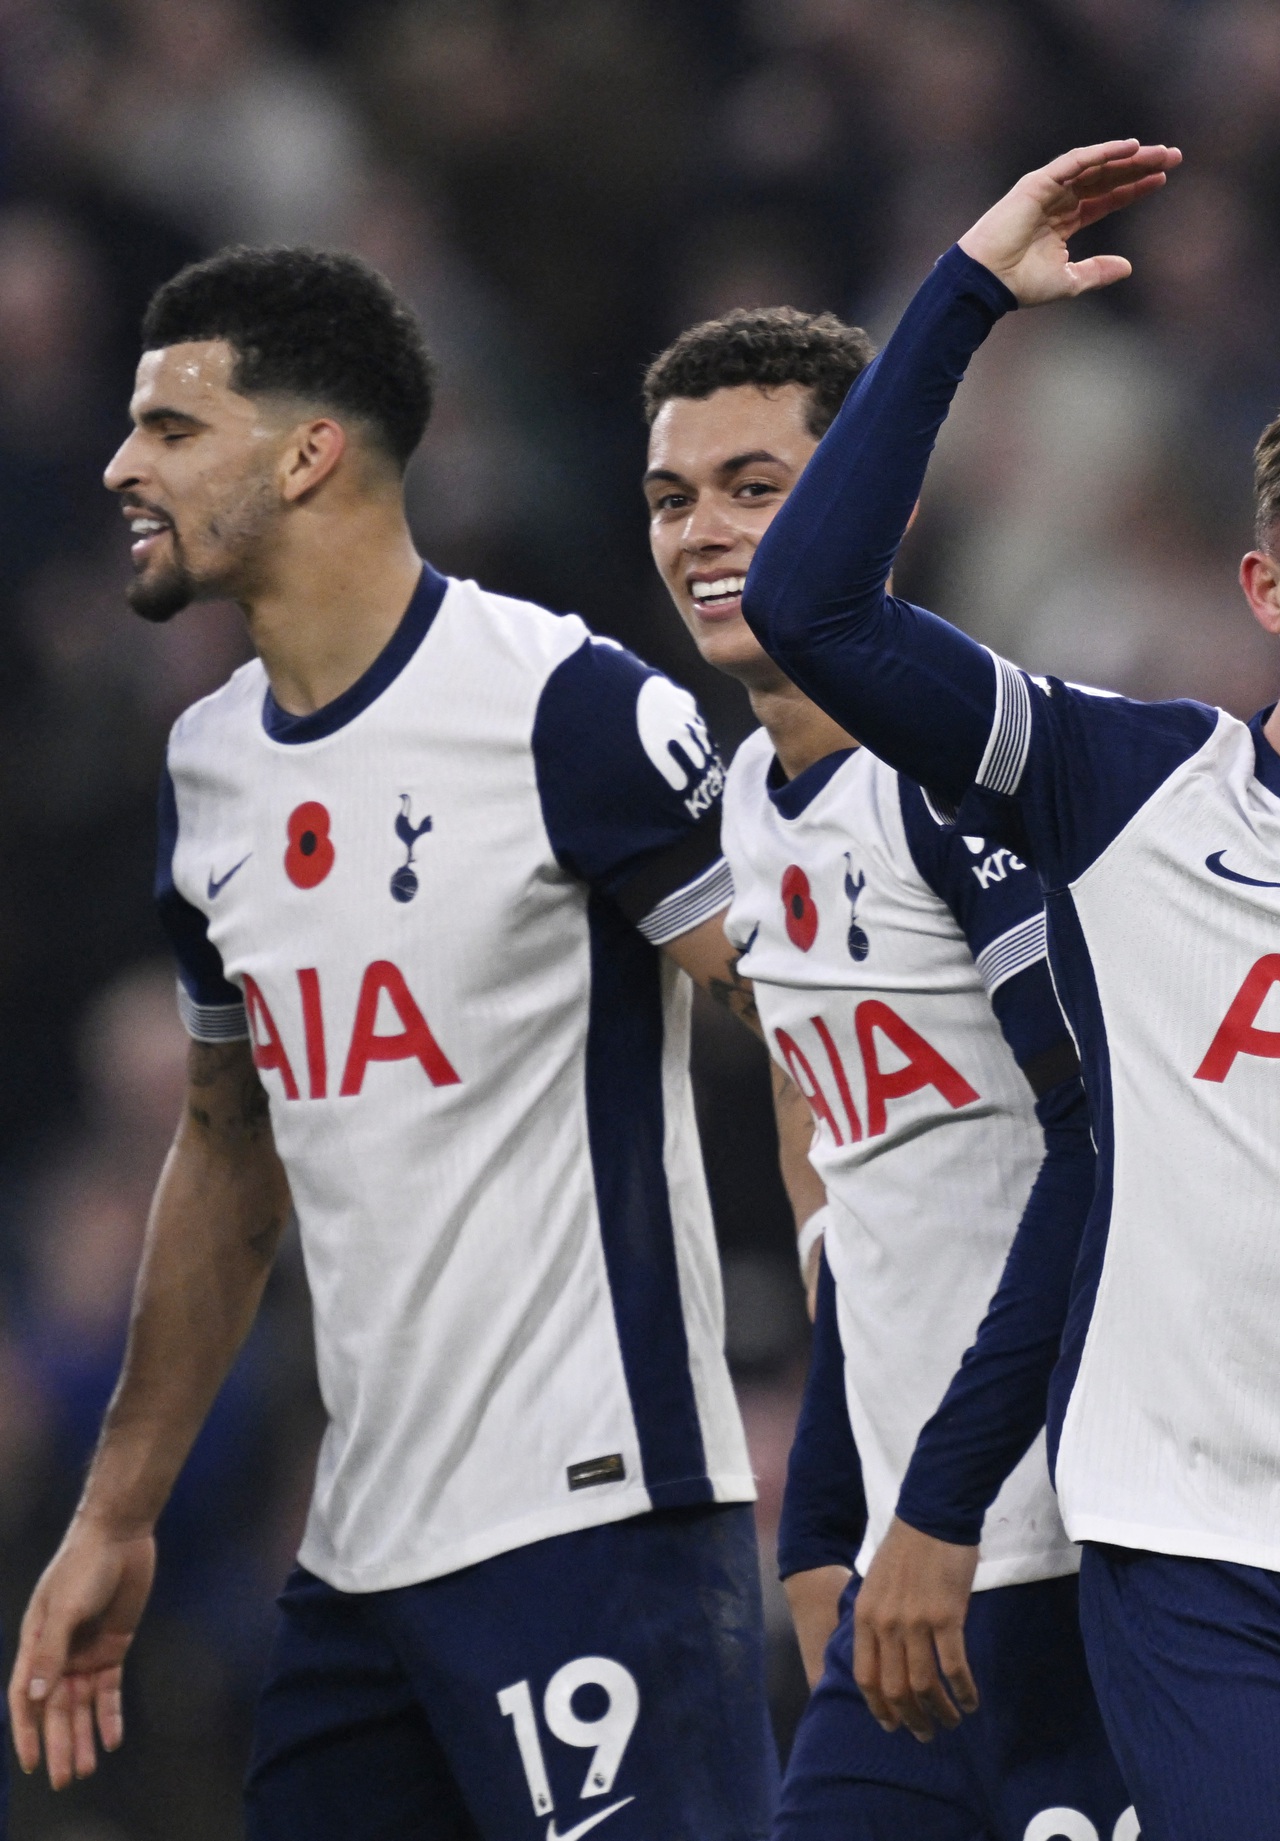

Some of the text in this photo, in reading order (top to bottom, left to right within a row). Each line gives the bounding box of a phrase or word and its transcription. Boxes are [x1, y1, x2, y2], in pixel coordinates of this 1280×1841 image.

[242, 959, 462, 1101] AIA
[773, 999, 981, 1148] AIA
[496, 1655, 640, 1818] 19
